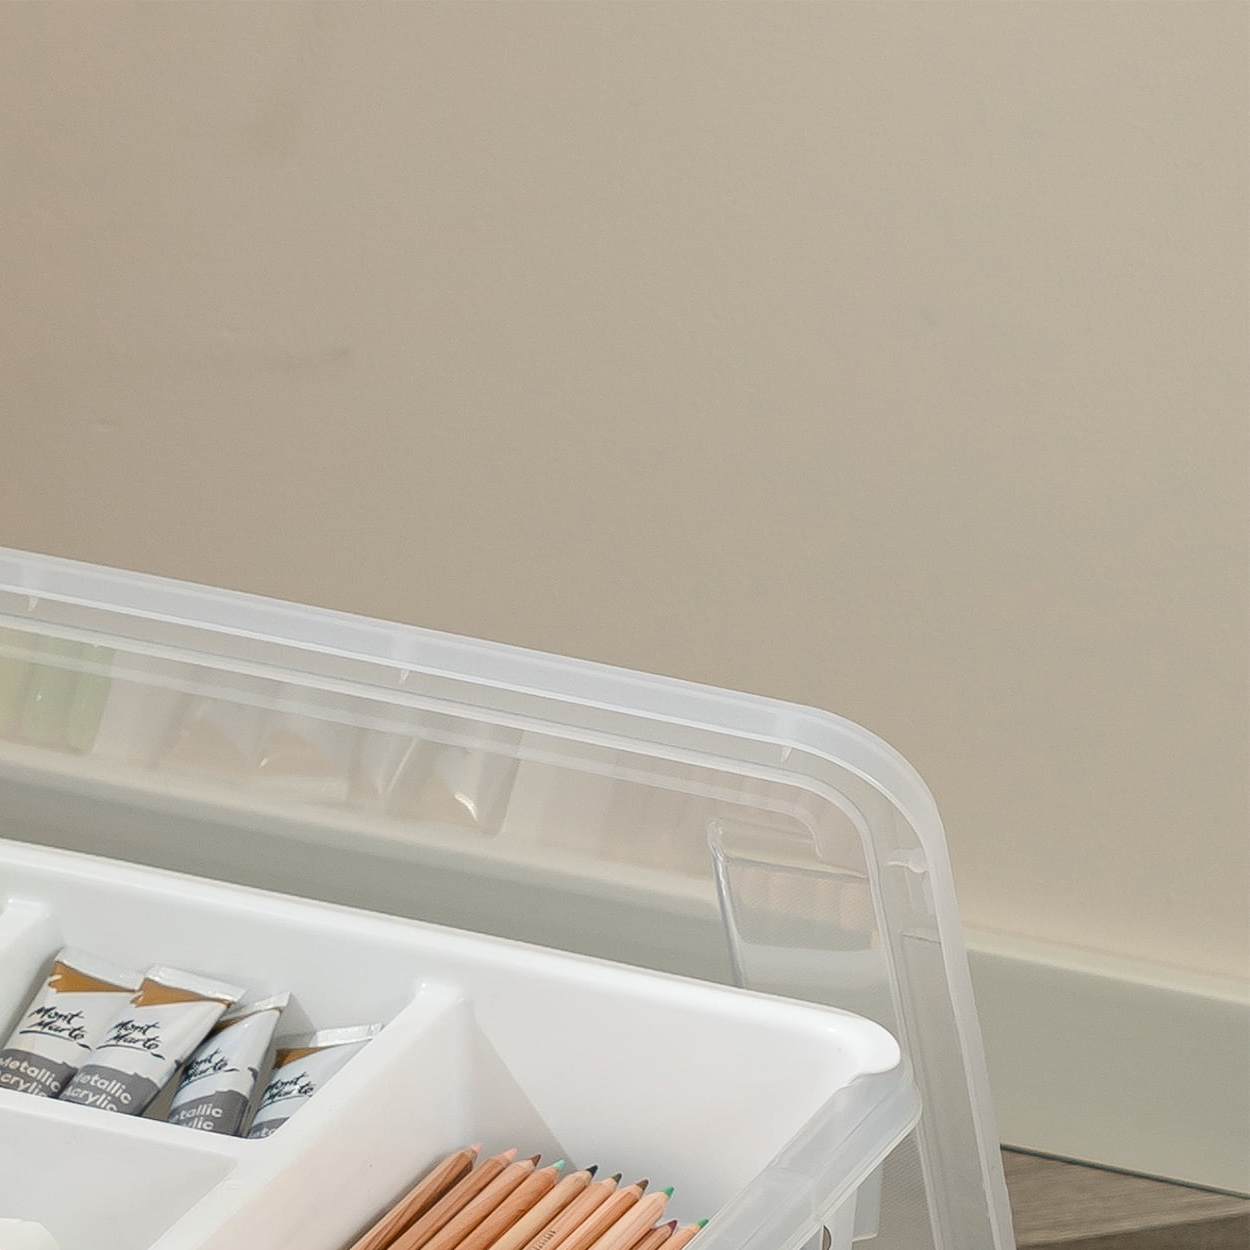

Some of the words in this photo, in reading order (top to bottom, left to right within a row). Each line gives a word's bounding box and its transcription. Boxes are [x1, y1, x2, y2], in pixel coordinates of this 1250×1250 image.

[28, 1007, 85, 1025] Mont
[28, 1020, 87, 1041] Marte
[107, 1019, 161, 1036] Mont
[105, 1032, 162, 1051] Marte
